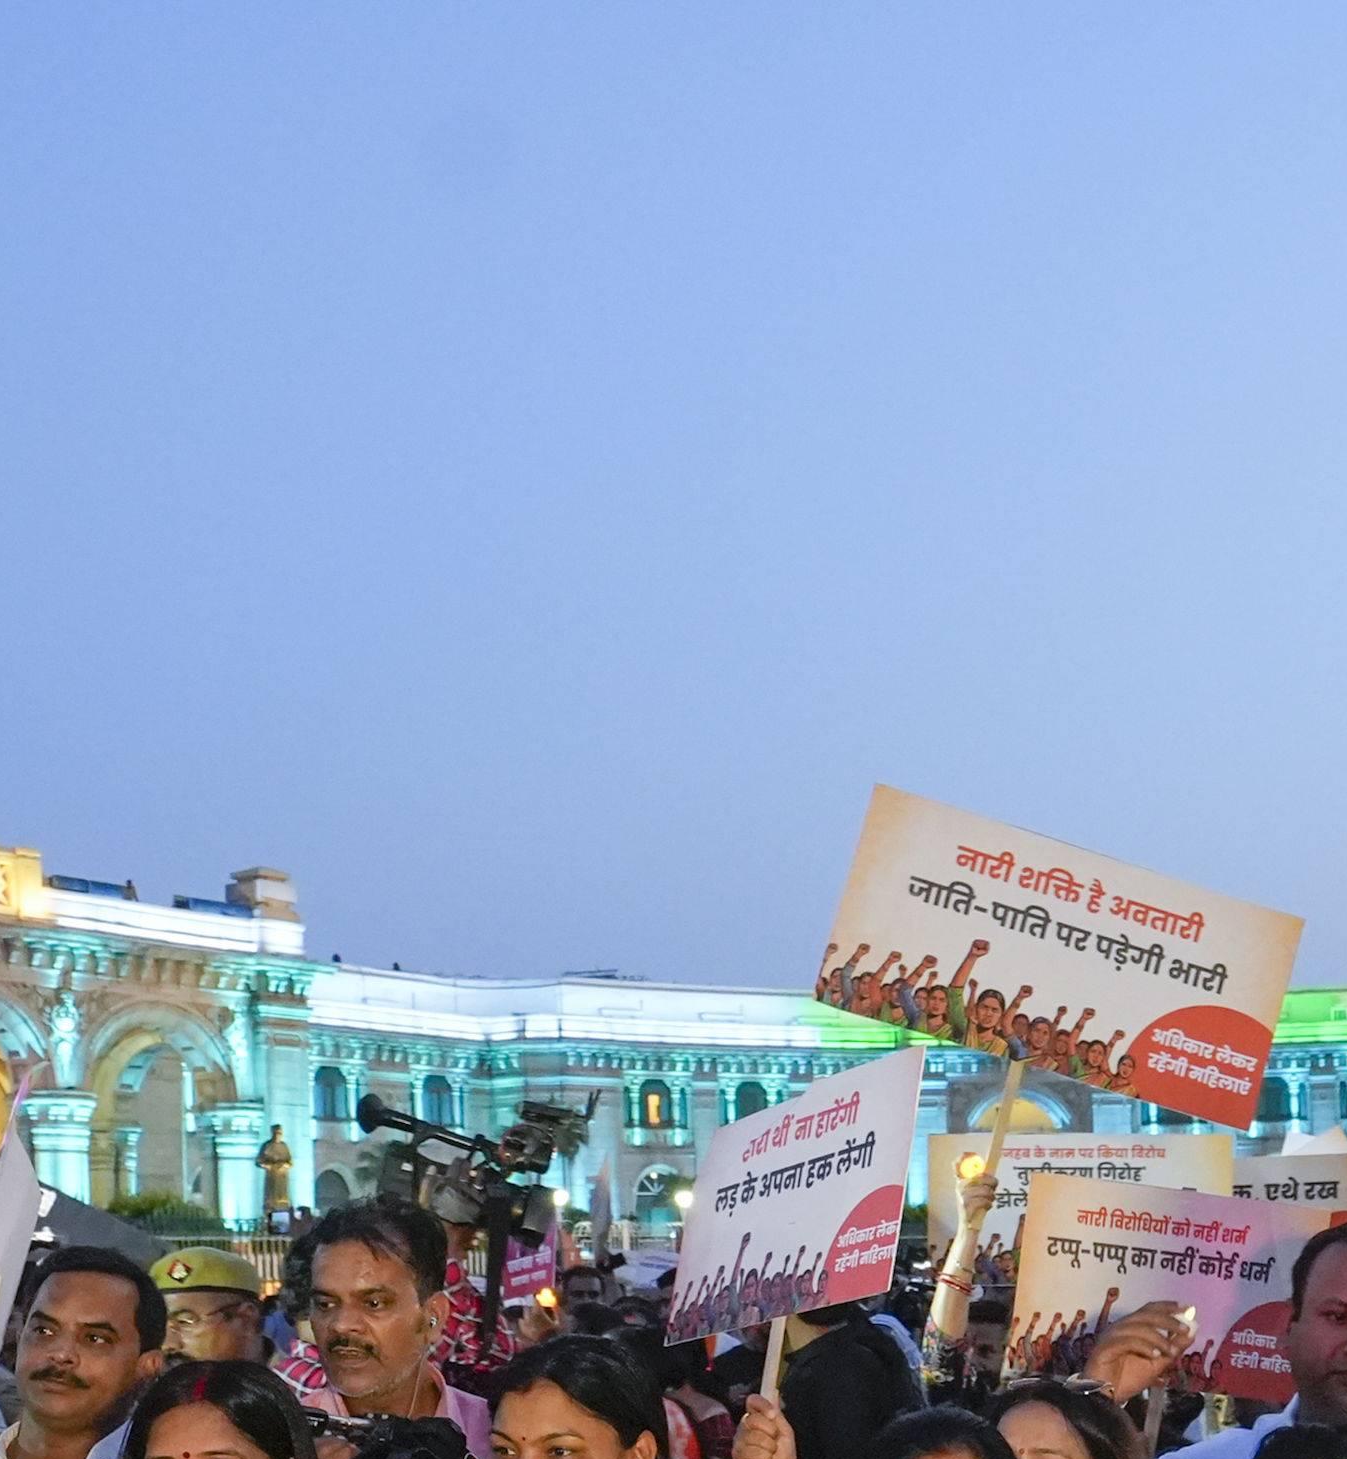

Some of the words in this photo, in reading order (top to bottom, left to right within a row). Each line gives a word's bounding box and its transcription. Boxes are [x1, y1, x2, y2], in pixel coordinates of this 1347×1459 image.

[957, 846, 1015, 882] नारी
[1019, 867, 1084, 902] शक्ति
[1087, 879, 1106, 913] है
[1110, 896, 1204, 942] अवतारी
[908, 874, 1051, 939] जाति-पाति
[1056, 922, 1092, 951] पर
[1097, 934, 1165, 974] पड़ेगी
[1169, 959, 1228, 994] भारी
[1152, 1029, 1215, 1059] अधिकार
[1216, 1045, 1258, 1072] लेकर
[1148, 1051, 1194, 1077] रहेंगी
[1189, 1064, 1252, 1096] महिलाएं
[772, 1114, 794, 1147] थीं
[795, 1115, 815, 1140] ना
[815, 1091, 860, 1138] हारेंगी
[1001, 1146, 1030, 1159] जहब
[1034, 1144, 1045, 1158] के
[1048, 1148, 1076, 1158] नाम
[1078, 1148, 1095, 1158] पर
[1097, 1144, 1129, 1158] किया
[1131, 1144, 1166, 1158] विरोध
[716, 1183, 740, 1217] लड़
[741, 1171, 758, 1203] के
[759, 1162, 805, 1197] अपना
[806, 1153, 835, 1188] हक
[837, 1131, 875, 1175] लेंगी
[1304, 1181, 1340, 1200] रख
[836, 1226, 876, 1248] अधिकार
[1078, 1207, 1108, 1227] नारी
[1110, 1209, 1172, 1235] विरोधियों
[1172, 1218, 1191, 1237] को
[1194, 1221, 1222, 1243] नहीं
[1222, 1225, 1250, 1245] शर्म
[835, 1249, 859, 1272] रहेंगी
[1047, 1237, 1128, 1274] टप्पू-पप्पू
[1131, 1247, 1157, 1269] का
[1161, 1246, 1199, 1275] नहीं
[1199, 1251, 1239, 1280] कोई
[1240, 1257, 1276, 1283] धर्म
[1231, 1350, 1259, 1368] रहेंगी
[1232, 1329, 1277, 1349] अधिकार
